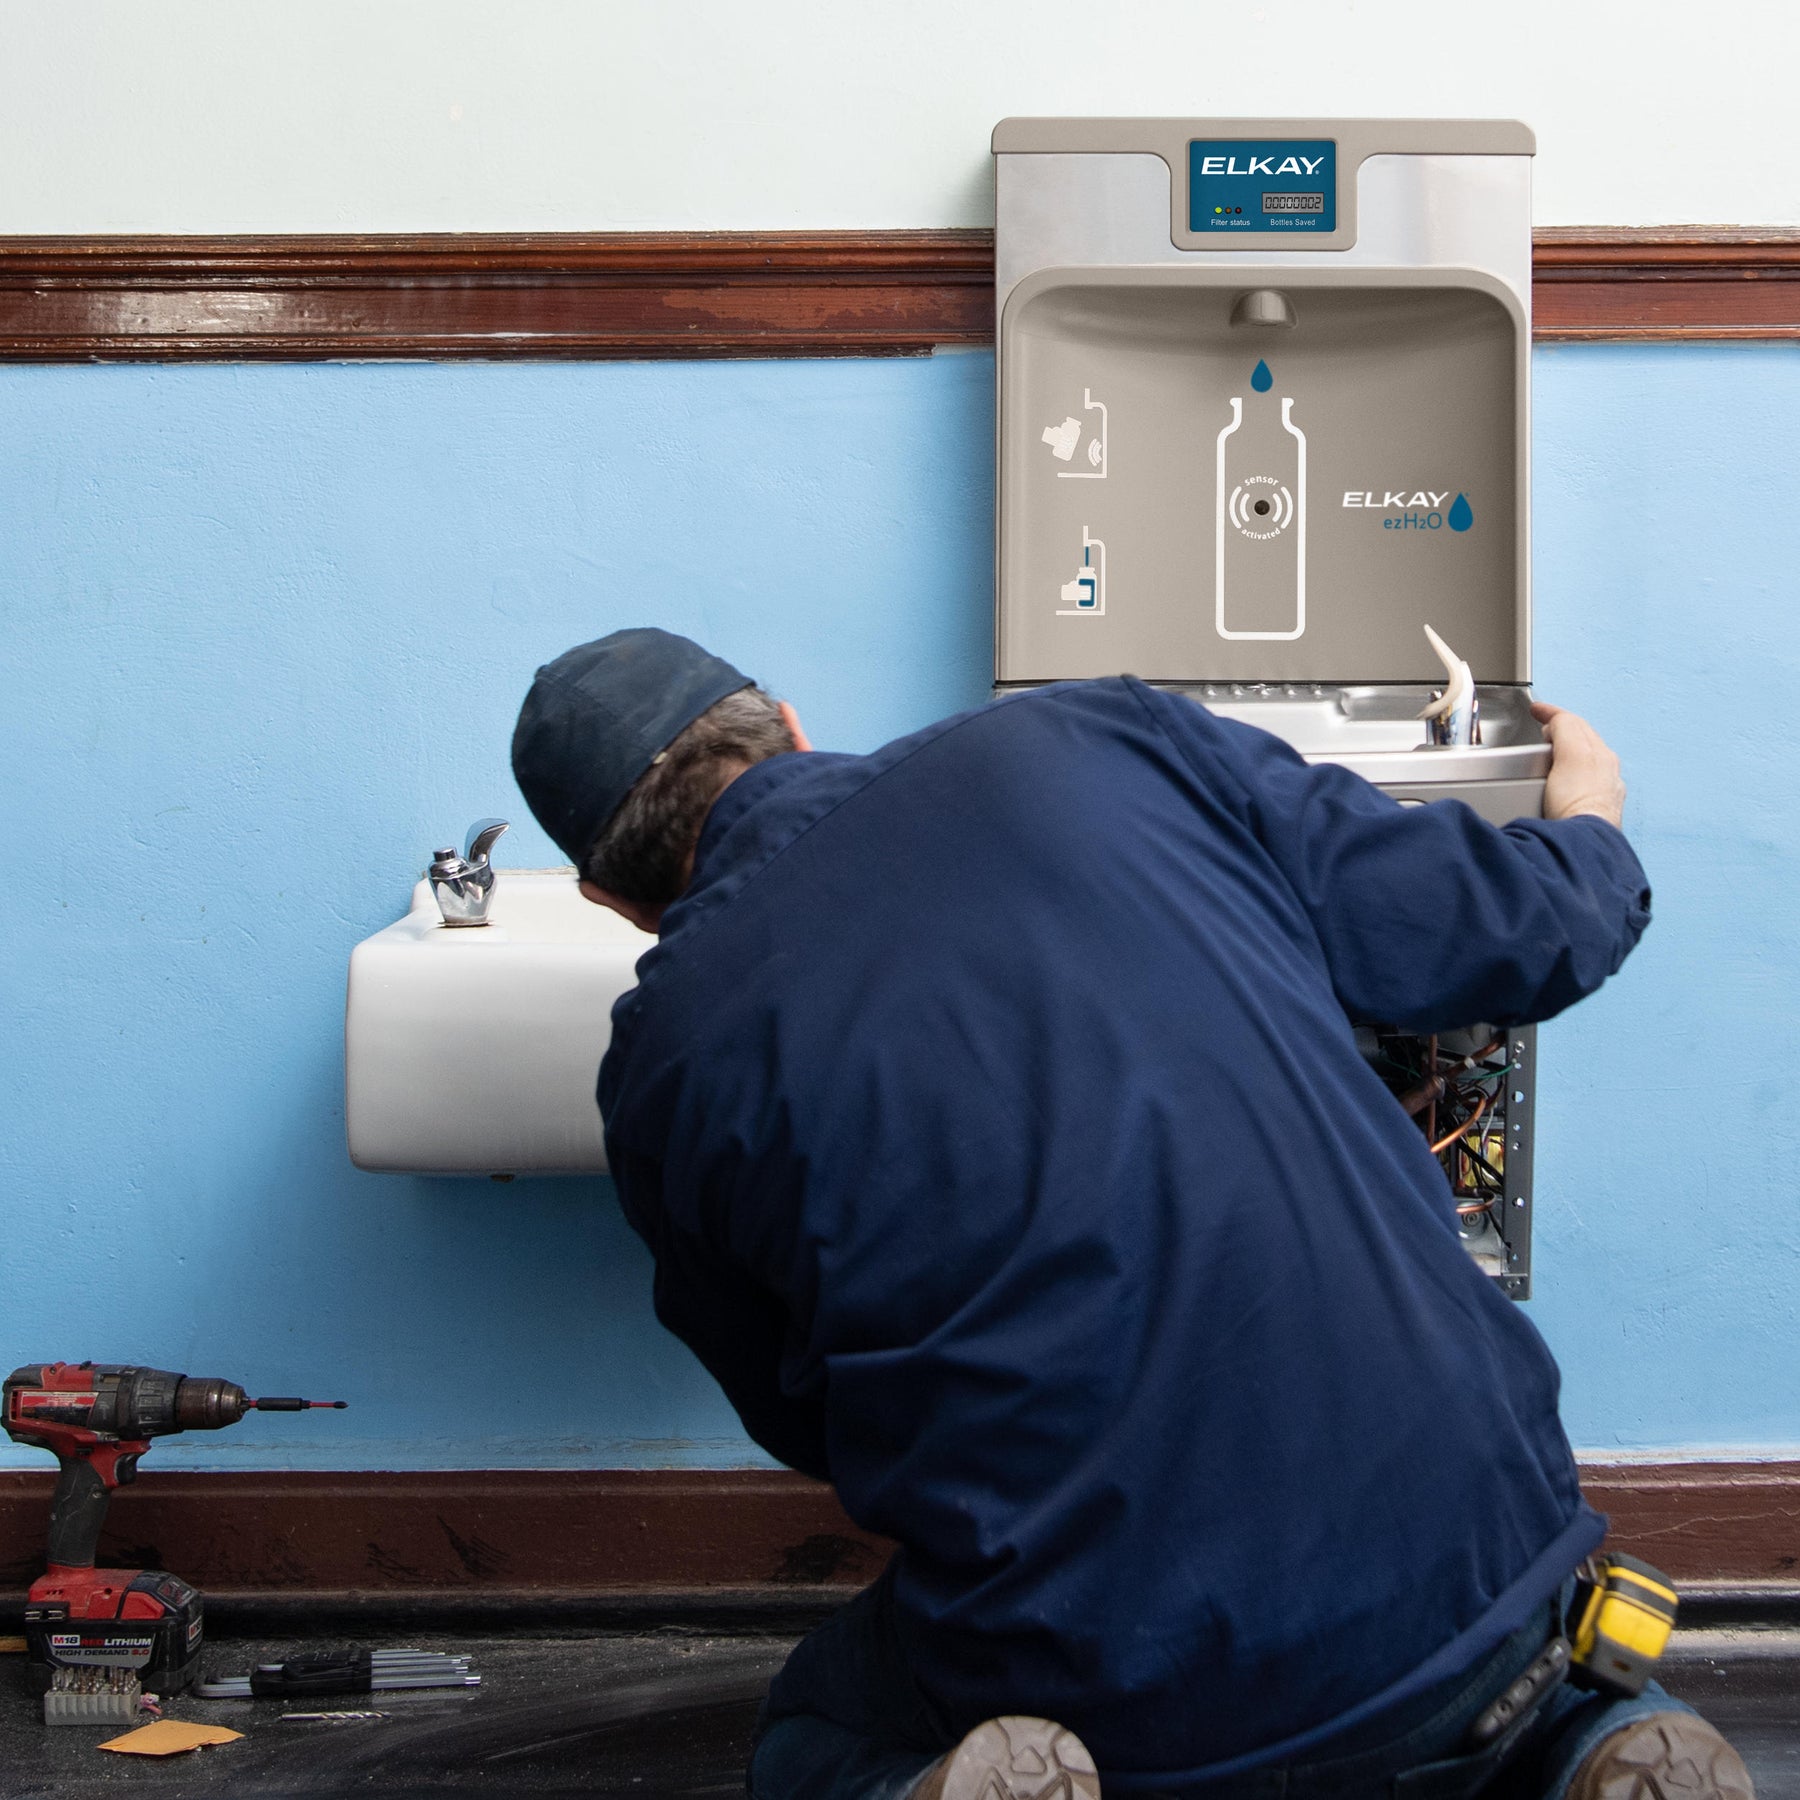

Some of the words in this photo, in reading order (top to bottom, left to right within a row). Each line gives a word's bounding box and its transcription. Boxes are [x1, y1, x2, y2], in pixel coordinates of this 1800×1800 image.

[1201, 156, 1325, 175] ELKAY
[1264, 196, 1322, 209] 00000002
[1210, 218, 1228, 226] Filter
[1230, 218, 1251, 226] status
[1270, 218, 1293, 226] Bottles
[1295, 218, 1316, 226] Saved
[1244, 475, 1280, 486] sensor
[1342, 491, 1449, 508] ELKAY
[1241, 527, 1281, 540] activated
[53, 1636, 80, 1645] M18
